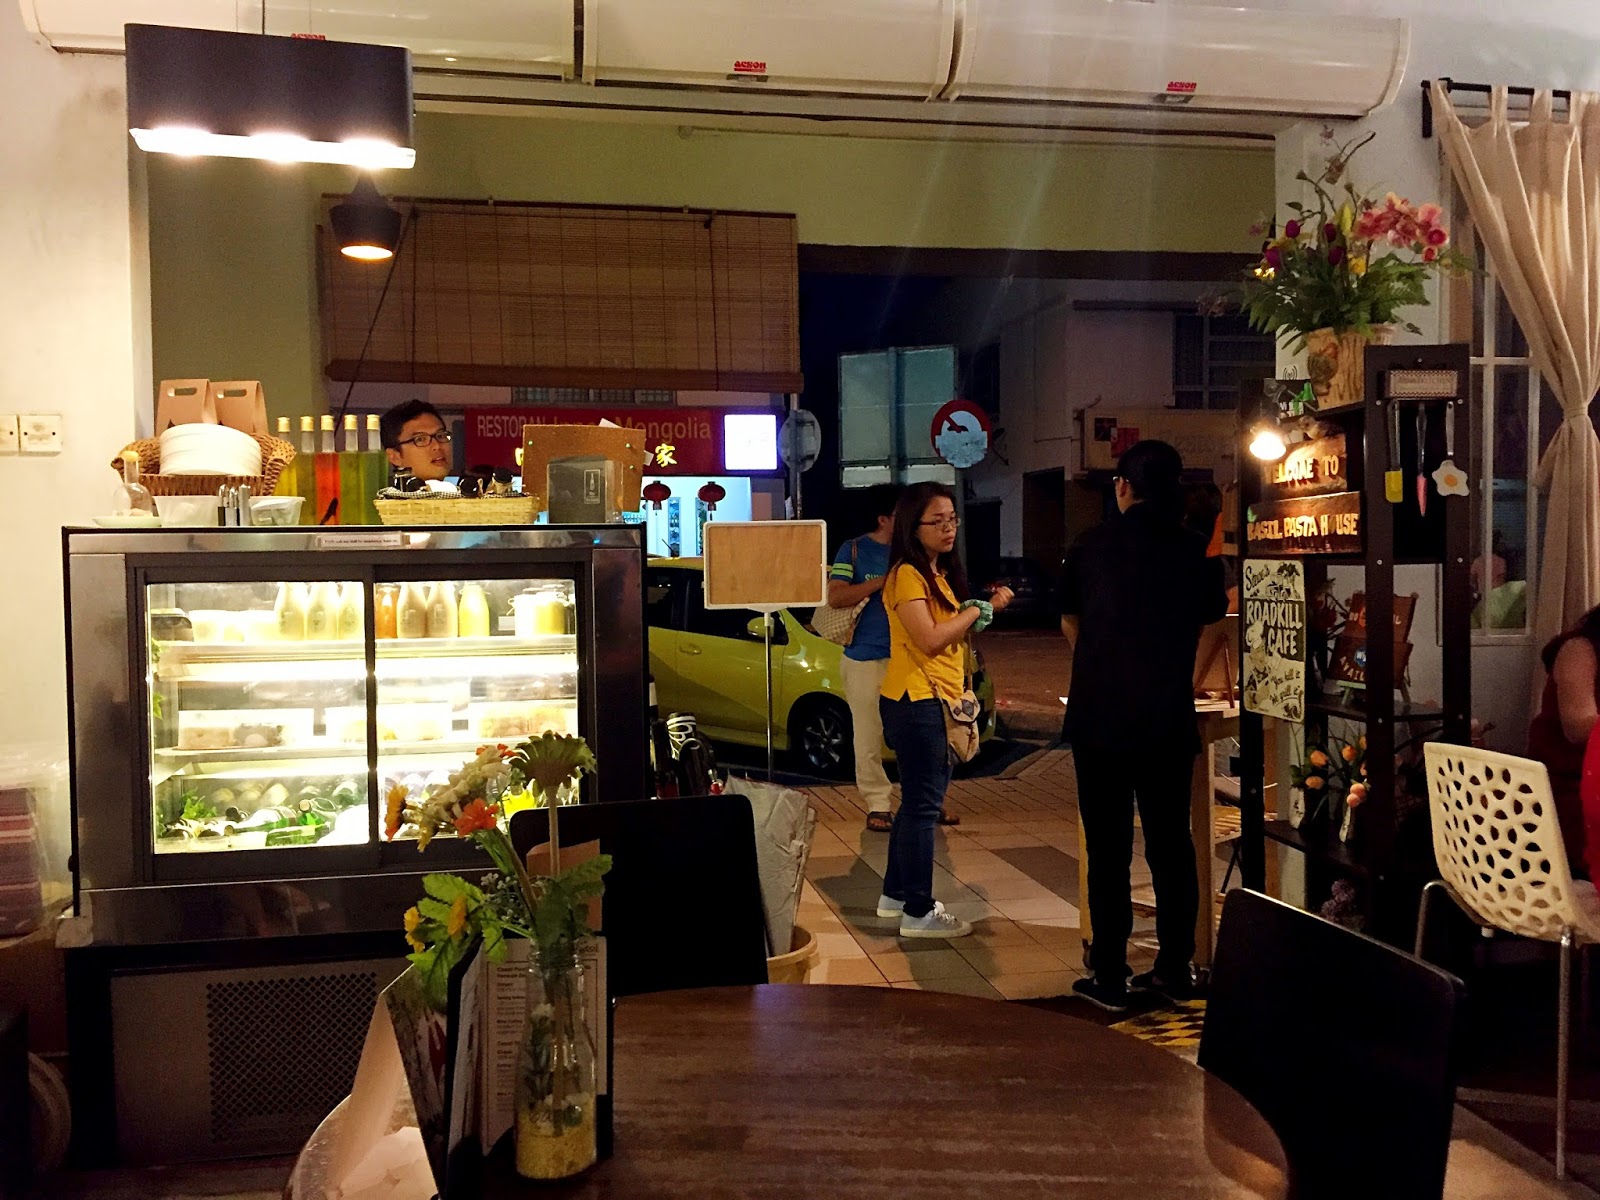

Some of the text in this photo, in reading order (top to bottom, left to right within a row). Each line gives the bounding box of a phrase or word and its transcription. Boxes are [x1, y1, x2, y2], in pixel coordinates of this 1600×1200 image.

[655, 443, 678, 468] 家
[1323, 454, 1339, 476] TO
[1247, 519, 1283, 541] BASIL
[1283, 514, 1319, 538] PASTA
[1246, 600, 1303, 629] ROADKILL
[1267, 627, 1298, 656] CAFE
